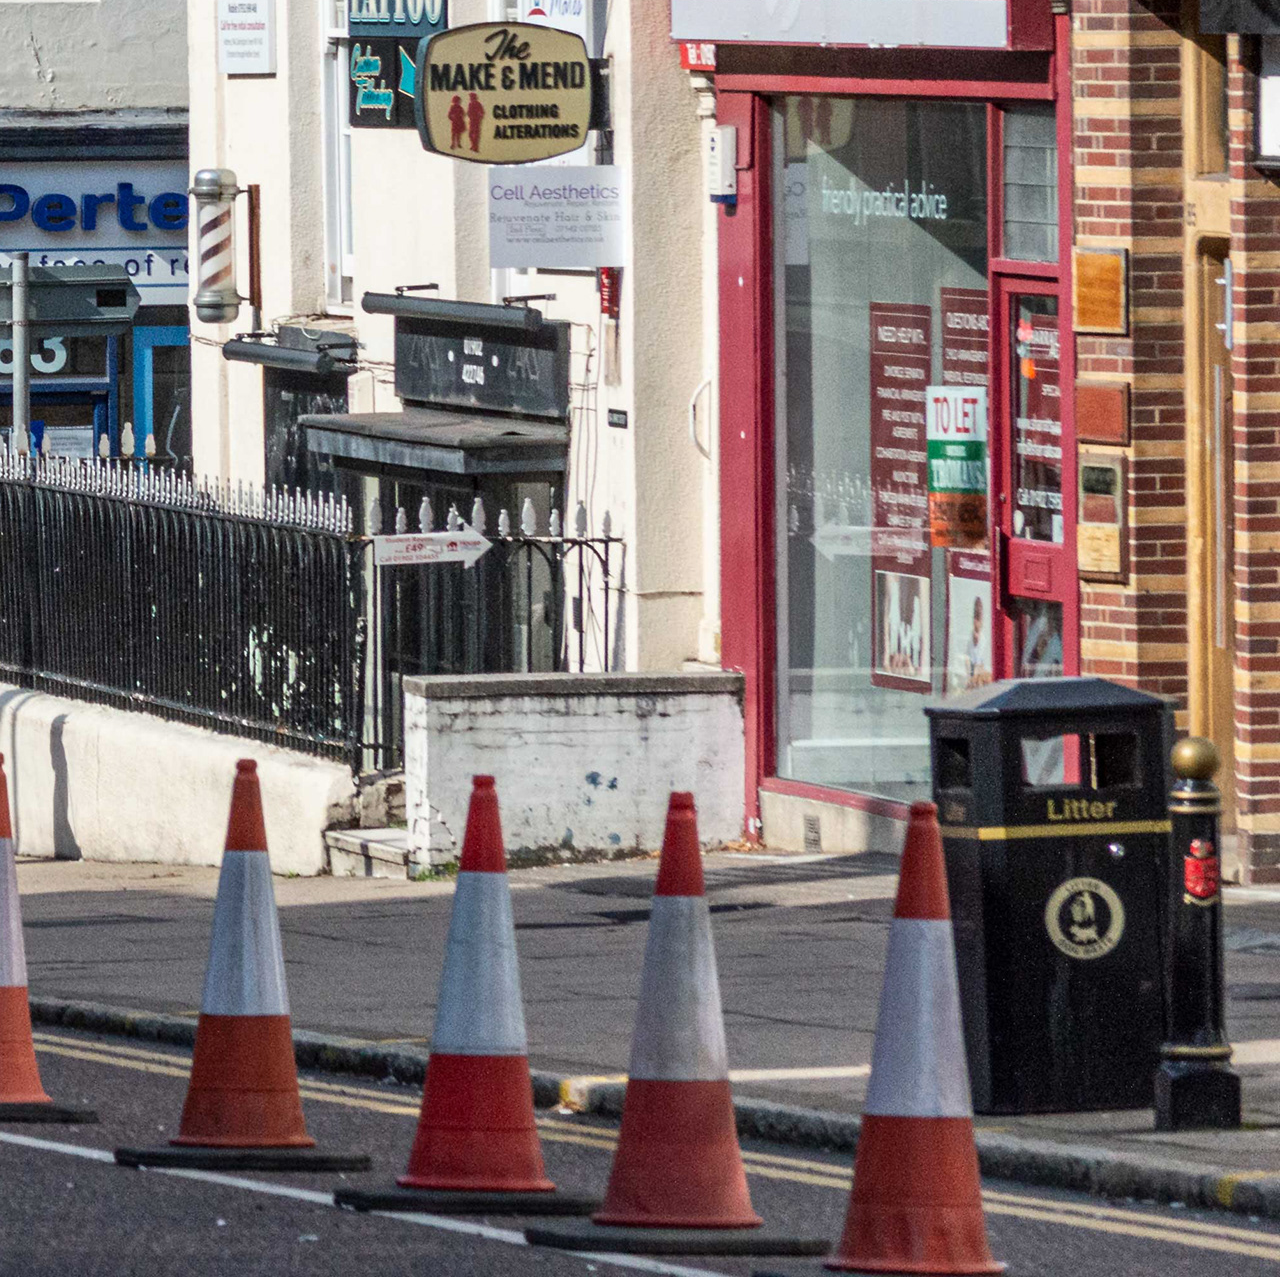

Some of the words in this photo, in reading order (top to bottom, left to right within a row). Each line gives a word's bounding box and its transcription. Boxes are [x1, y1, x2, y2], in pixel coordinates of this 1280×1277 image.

[484, 29, 532, 61] The
[430, 63, 496, 92] MAKE
[501, 66, 516, 91] &
[519, 61, 586, 91] MEND
[493, 104, 560, 120] CLOTHING
[494, 123, 580, 140] ALTERATIONS
[490, 184, 525, 201] Cell
[529, 184, 620, 200] Aesthetics
[911, 180, 947, 220] advice
[489, 212, 551, 224] Rejuvenate
[125, 253, 154, 276] of
[933, 397, 950, 434] TO
[954, 397, 979, 434] LET
[1046, 799, 1117, 821] Litter
